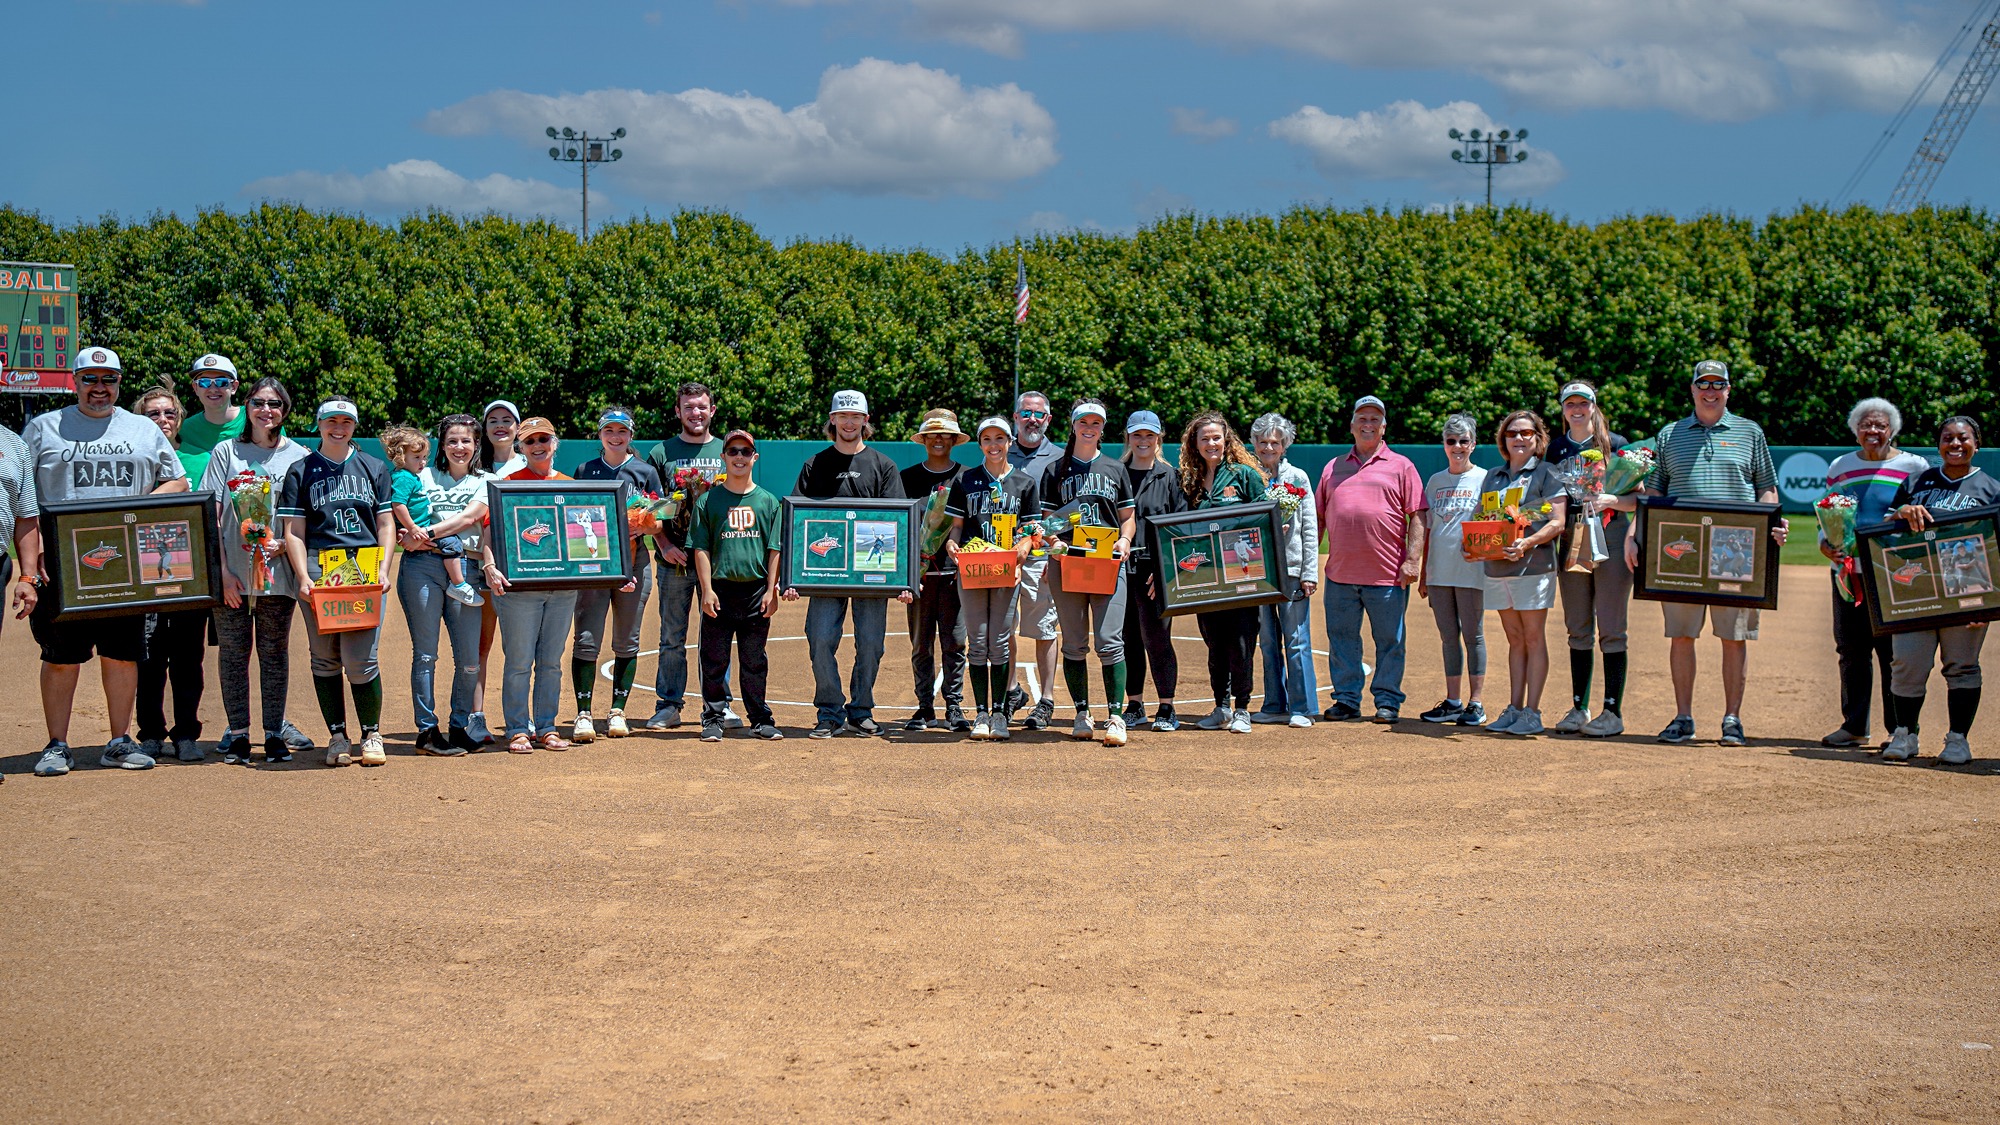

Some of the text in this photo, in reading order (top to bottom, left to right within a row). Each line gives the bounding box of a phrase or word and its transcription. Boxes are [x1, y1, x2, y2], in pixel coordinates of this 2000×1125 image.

[41, 295, 61, 306] H/E
[21, 325, 42, 335] HITS
[61, 440, 134, 462] Marisa's
[677, 457, 722, 468] UT DALLAS
[73, 461, 134, 488] DAD
[309, 474, 376, 511] UT DALLAS
[427, 489, 475, 504] Texa
[1075, 472, 1116, 503] DALLAS
[1446, 489, 1473, 498] DALLAS
[333, 507, 361, 535] 12
[727, 506, 756, 531] UTD
[1079, 502, 1102, 526] 21
[721, 530, 760, 539] SOFTBALL
